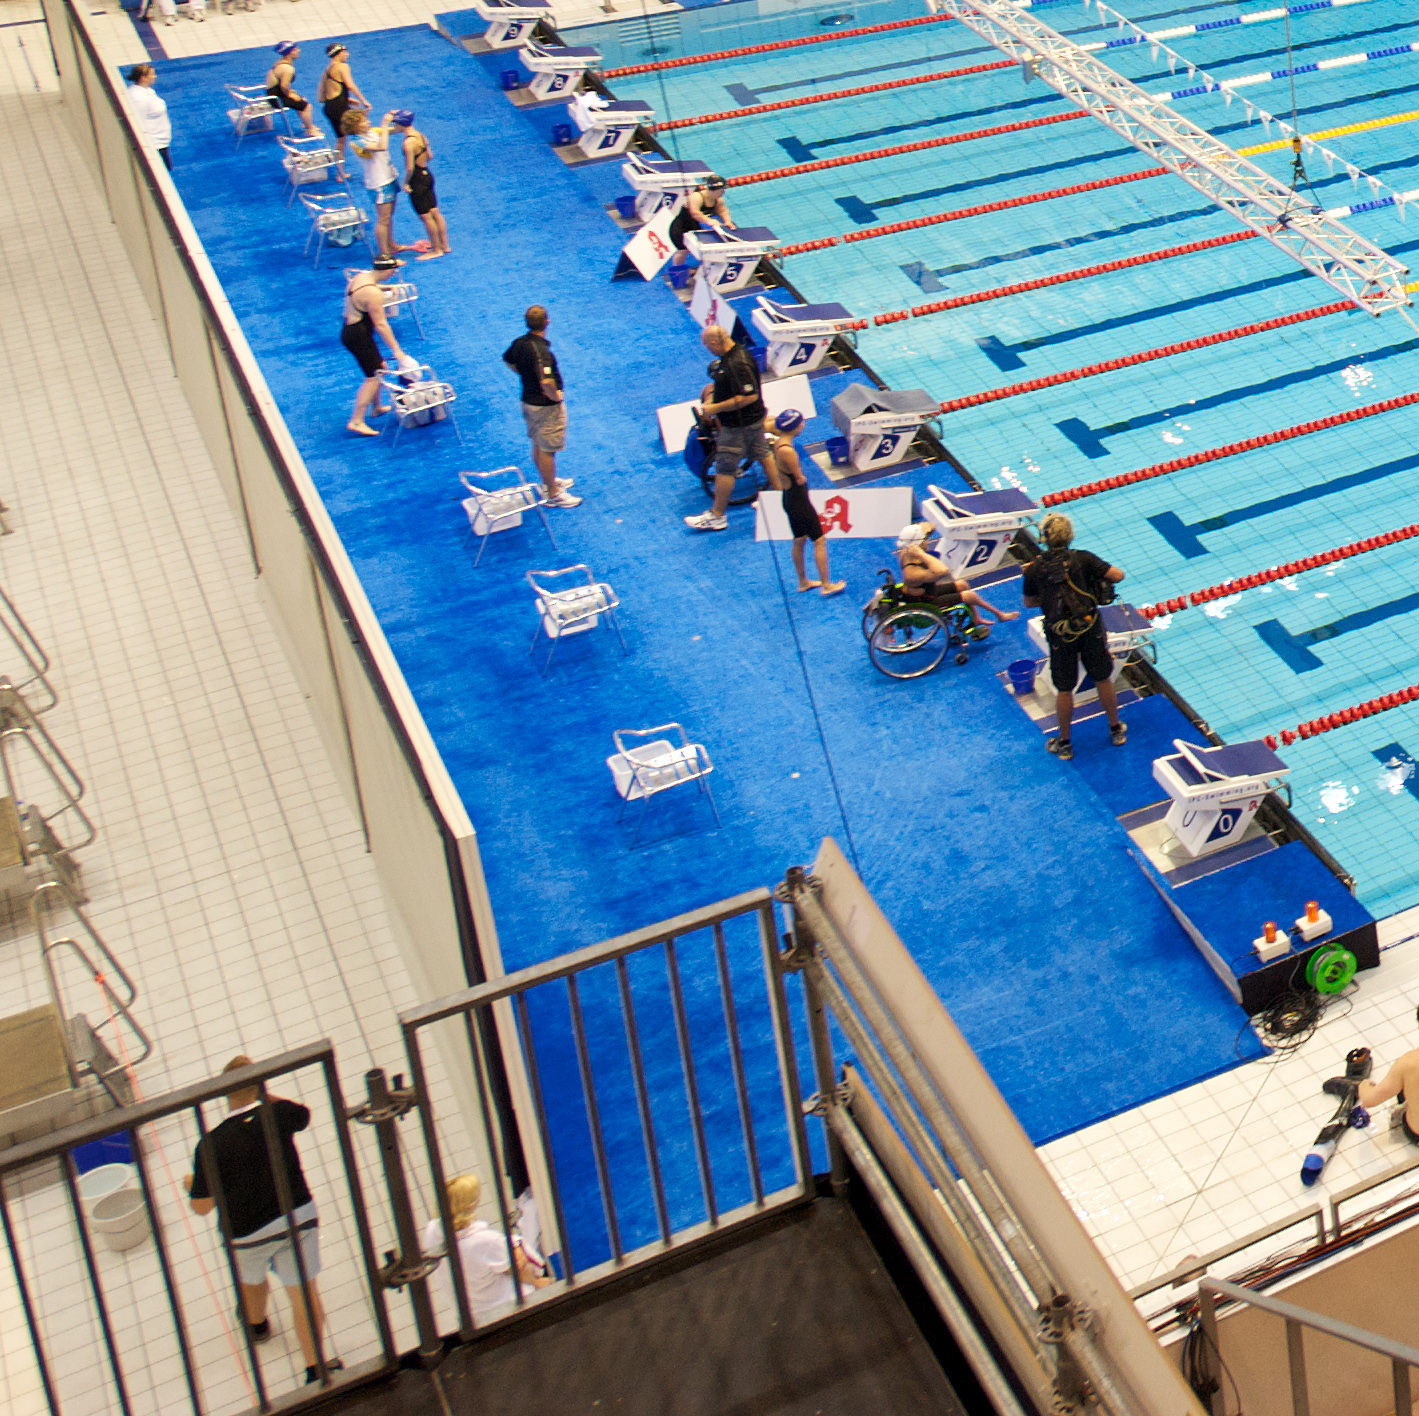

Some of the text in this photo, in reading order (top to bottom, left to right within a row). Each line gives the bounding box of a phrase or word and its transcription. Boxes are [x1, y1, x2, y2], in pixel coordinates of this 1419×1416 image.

[509, 25, 518, 39] 9
[554, 76, 564, 90] 8
[606, 130, 616, 146] 7
[726, 265, 738, 281] 5
[796, 345, 808, 364] 4
[881, 439, 894, 454] 3
[976, 544, 988, 561] 2
[1219, 813, 1234, 833] 0
